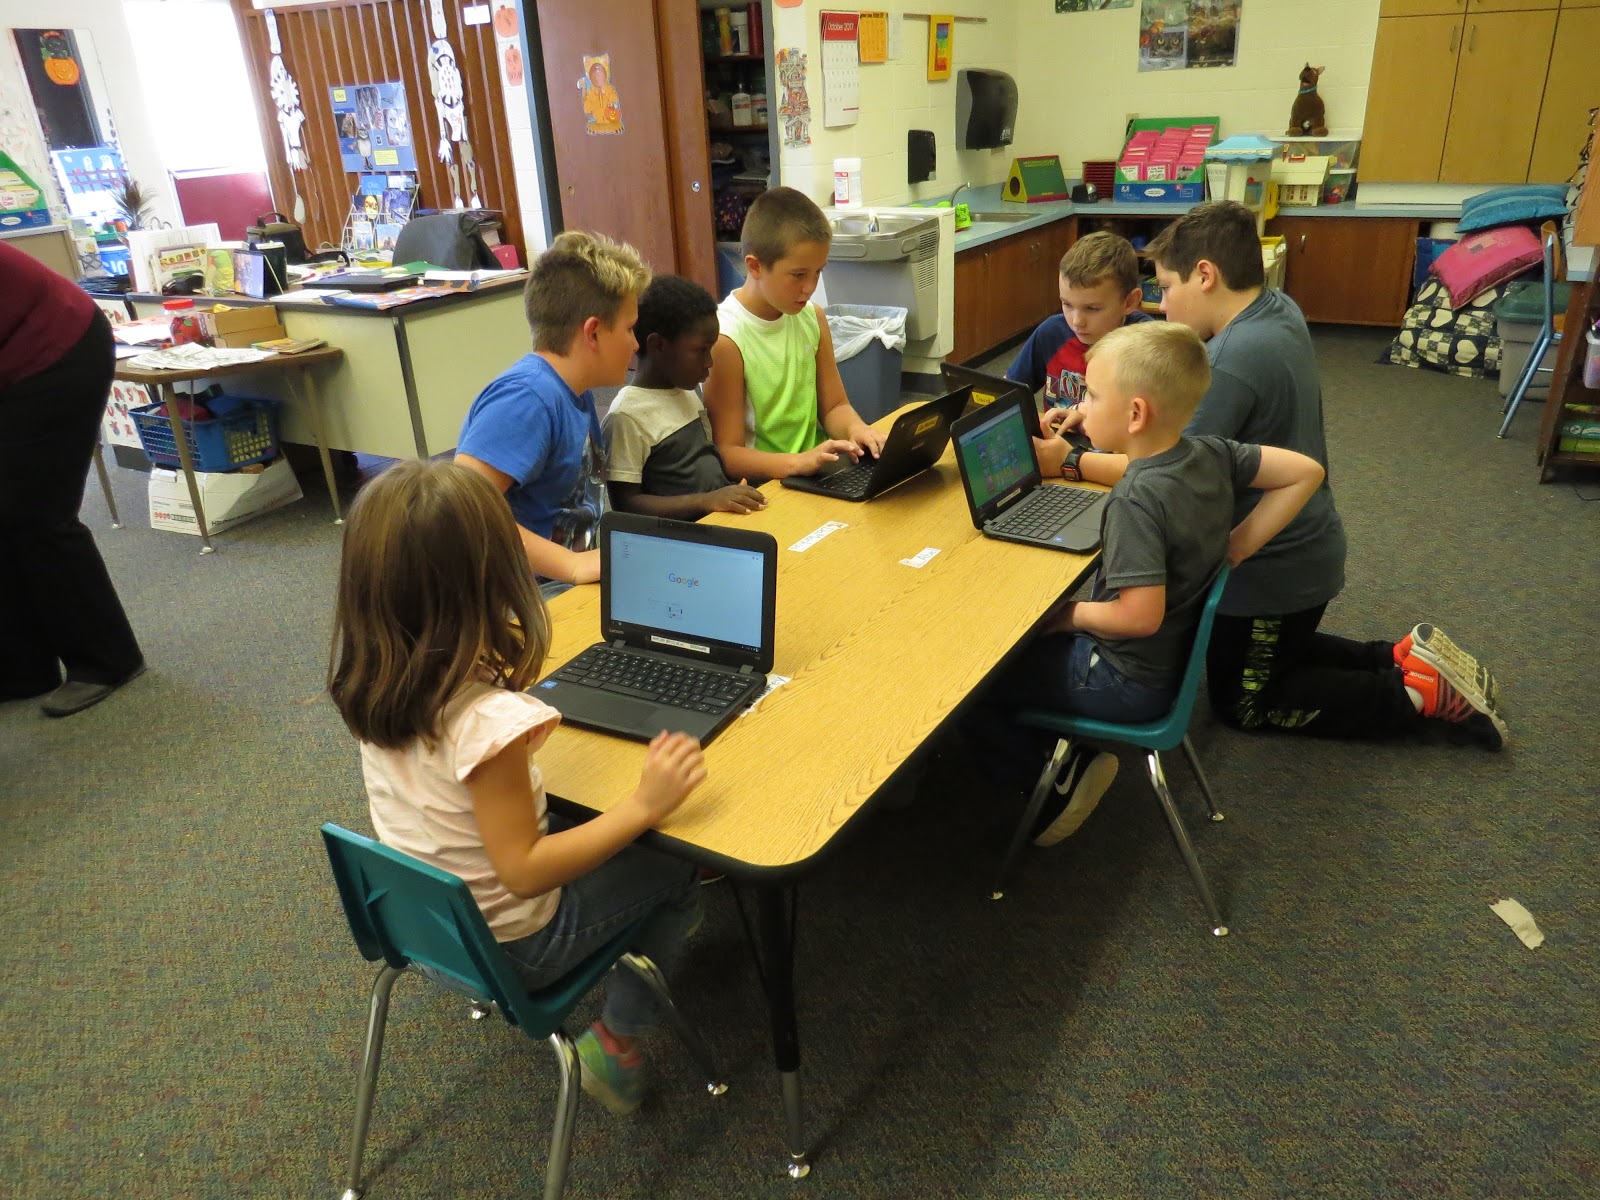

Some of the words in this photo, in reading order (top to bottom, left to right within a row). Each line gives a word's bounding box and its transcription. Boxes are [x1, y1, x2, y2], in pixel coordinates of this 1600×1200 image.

[828, 22, 843, 31] October
[844, 22, 854, 31] 2017
[668, 572, 699, 588] Google
